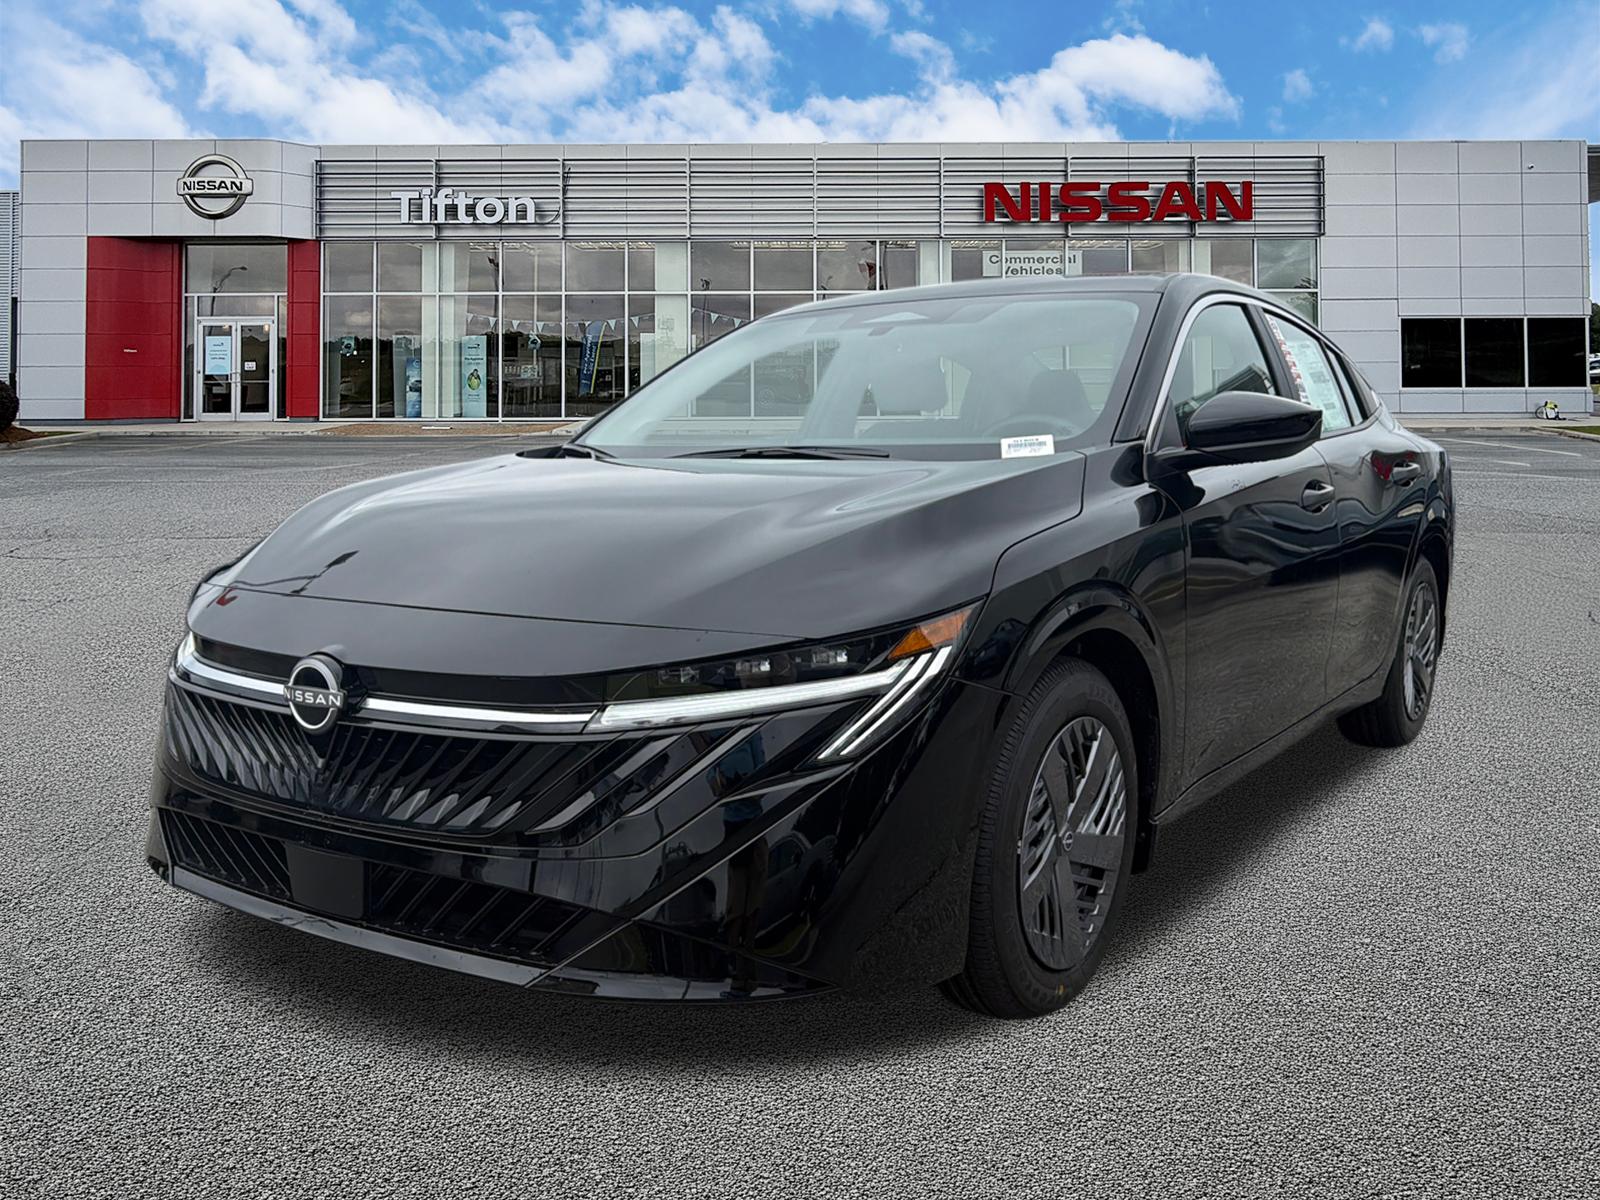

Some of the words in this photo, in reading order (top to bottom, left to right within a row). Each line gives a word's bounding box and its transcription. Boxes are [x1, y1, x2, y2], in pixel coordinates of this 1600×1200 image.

[182, 180, 243, 191] NISSAN
[391, 188, 536, 224] Tifton
[983, 181, 1253, 222] NISSAN
[283, 687, 341, 706] NISSAN
